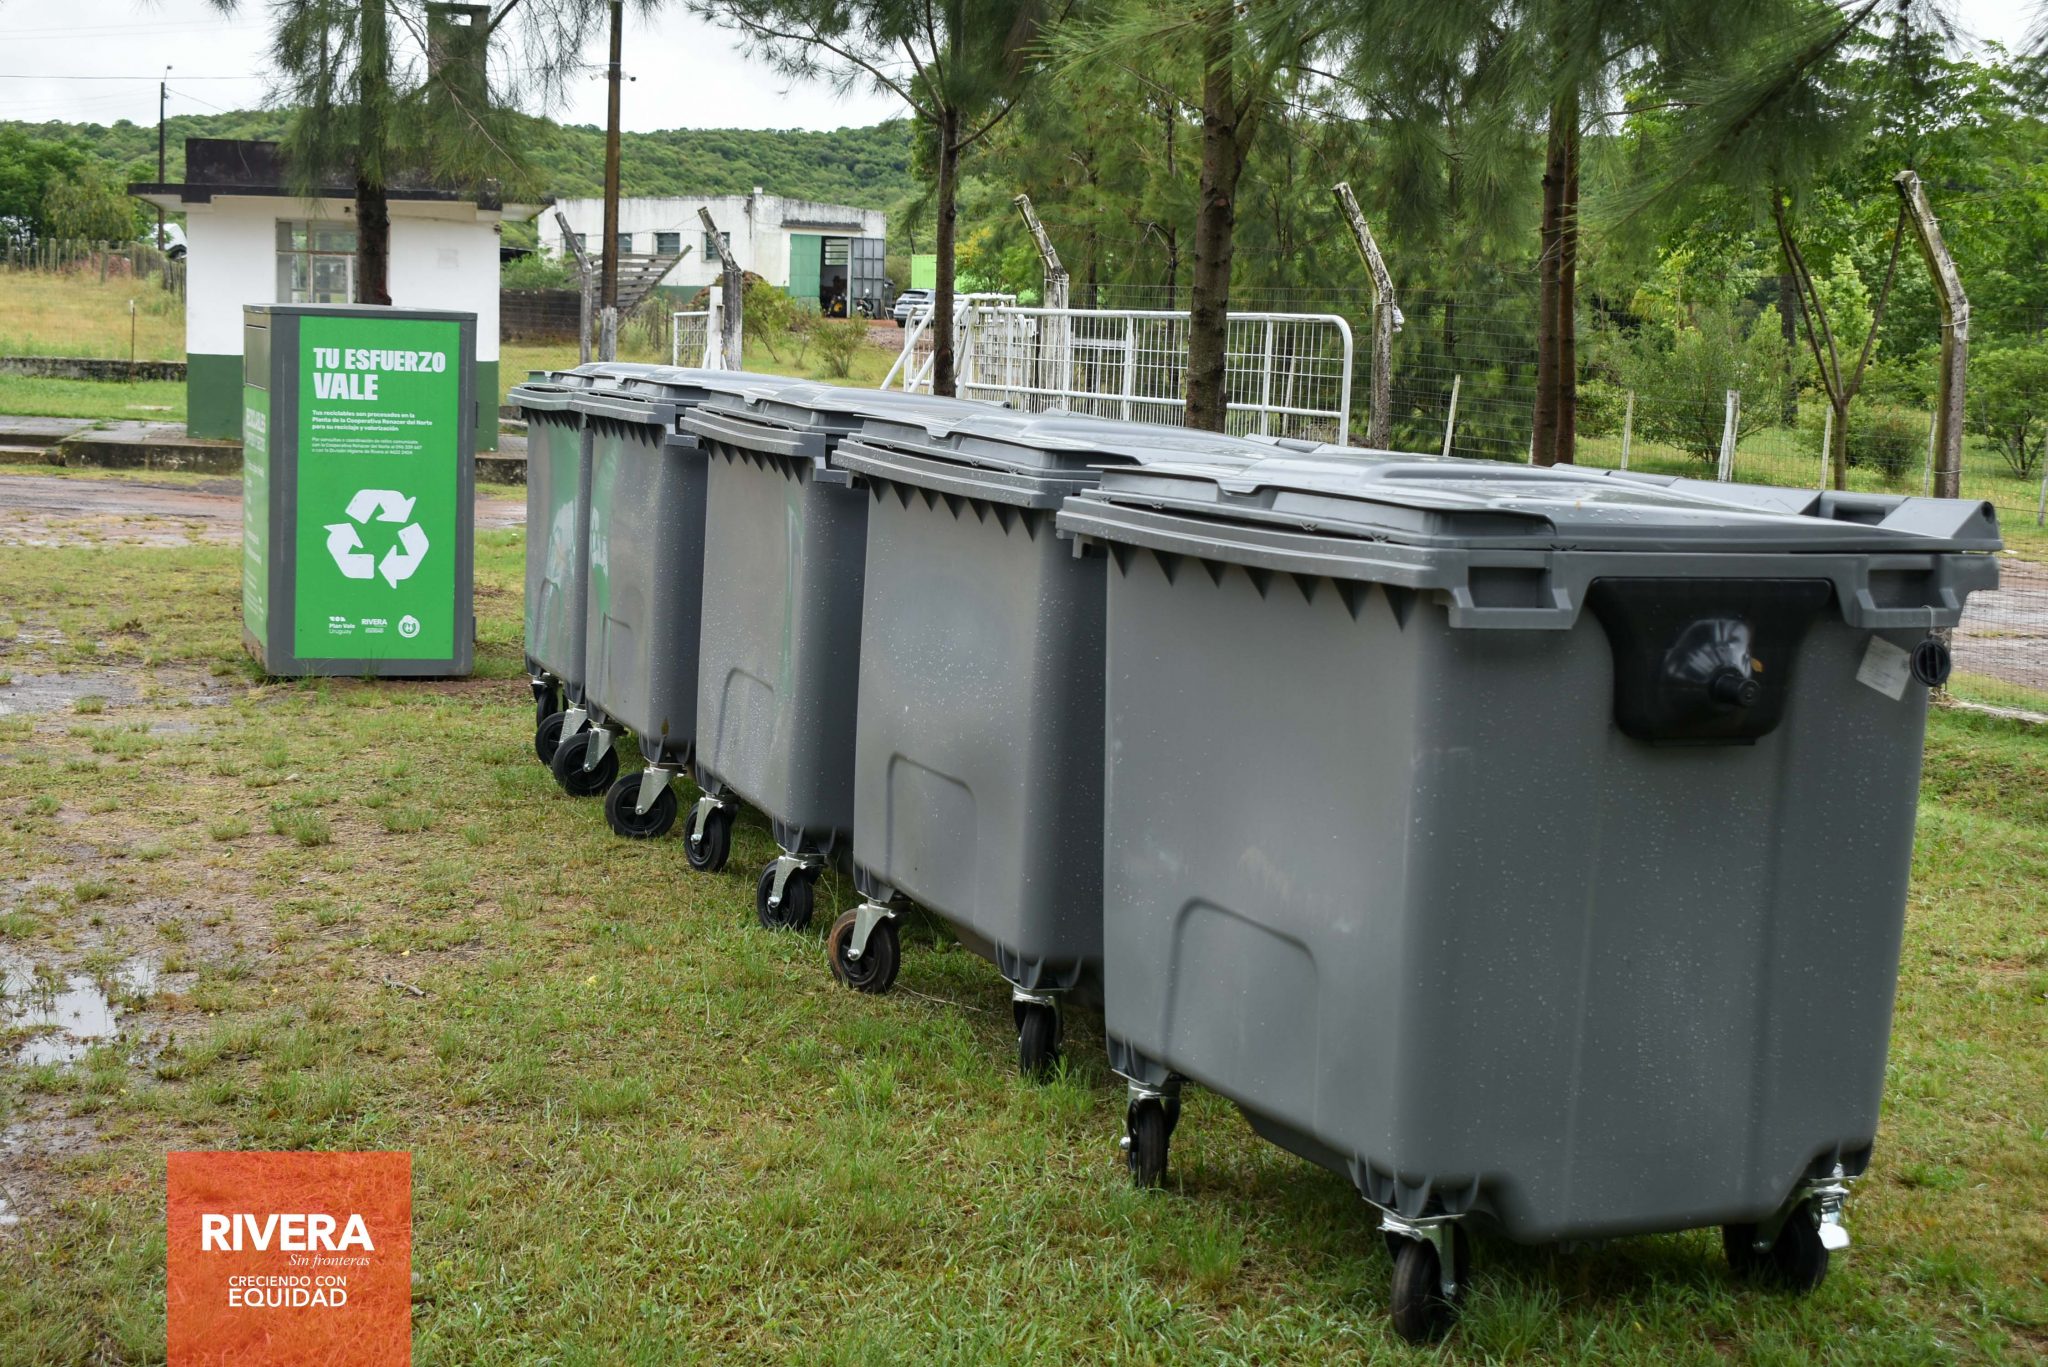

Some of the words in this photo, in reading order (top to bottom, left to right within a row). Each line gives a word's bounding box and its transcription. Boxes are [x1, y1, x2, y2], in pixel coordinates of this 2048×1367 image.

[313, 348, 340, 369] TU
[344, 349, 446, 373] ESFUERZO
[312, 372, 379, 401] VALE
[367, 411, 400, 419] procesados
